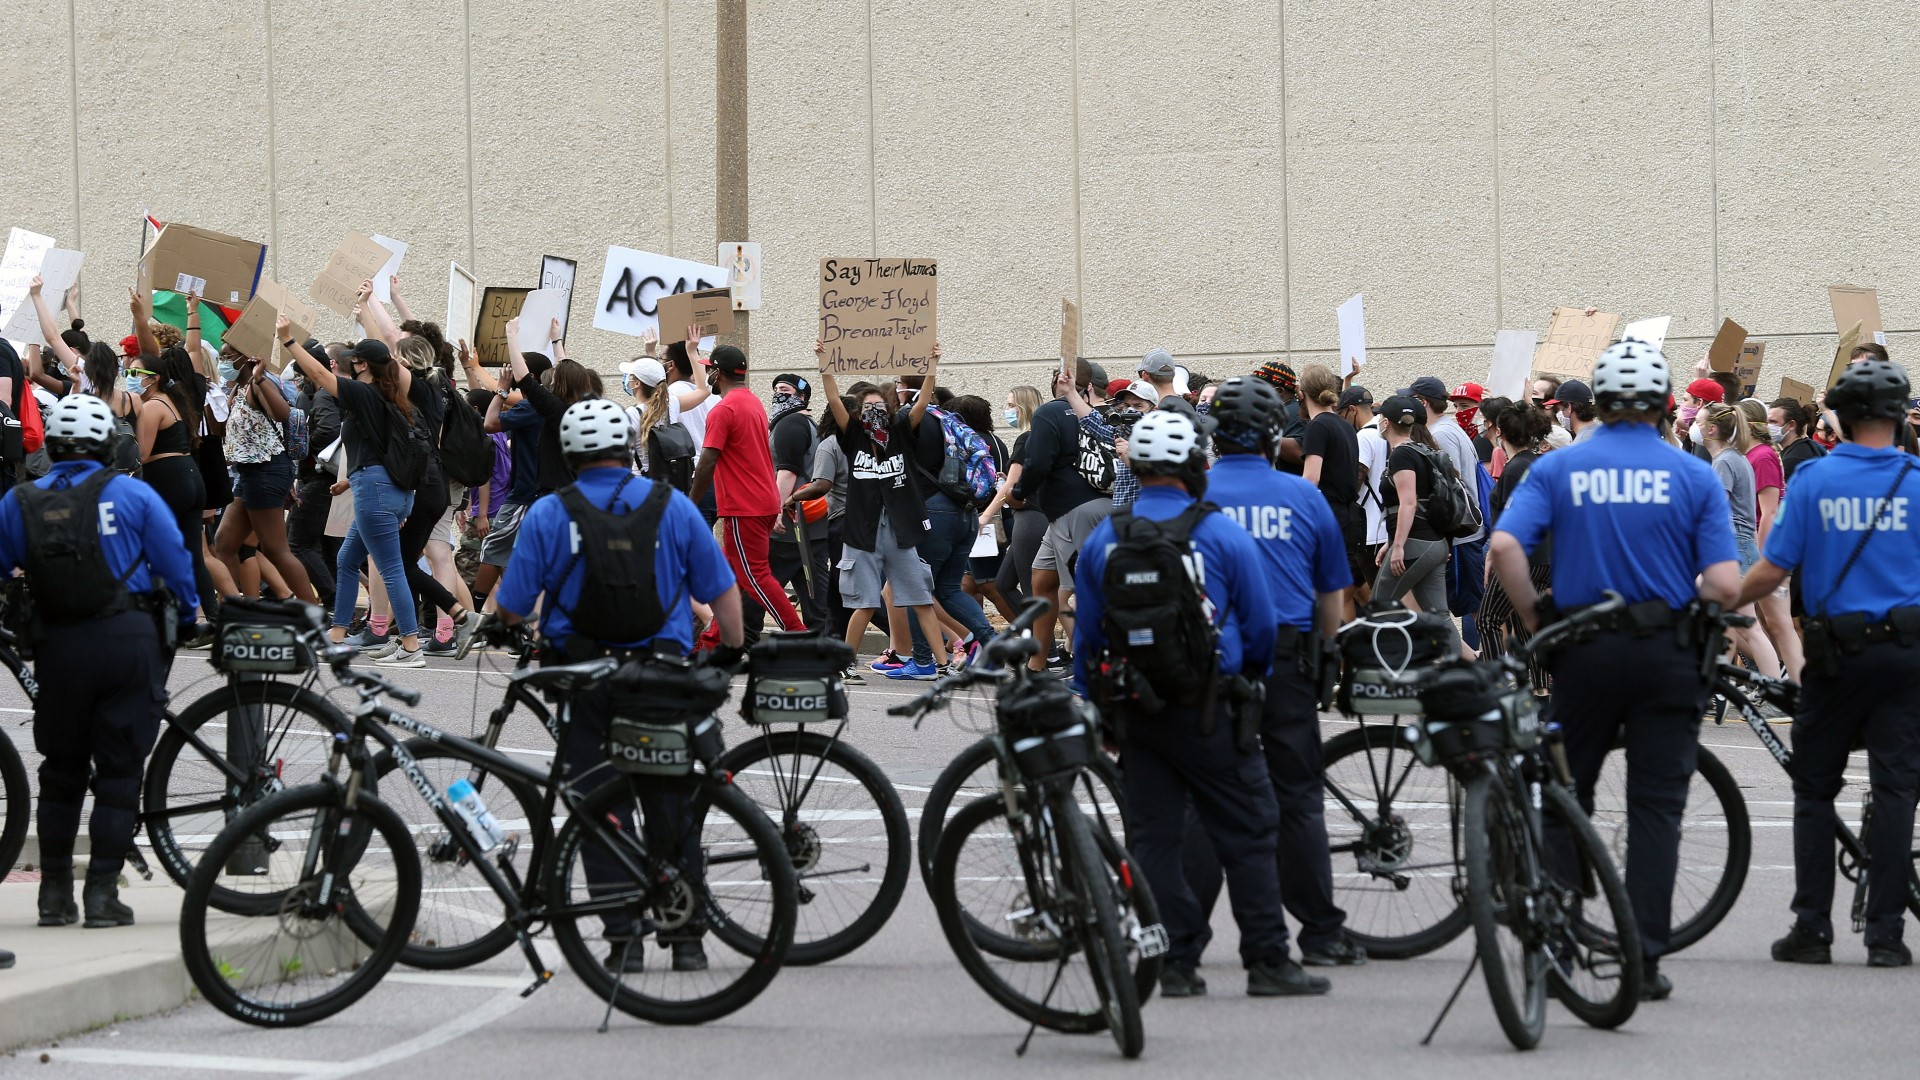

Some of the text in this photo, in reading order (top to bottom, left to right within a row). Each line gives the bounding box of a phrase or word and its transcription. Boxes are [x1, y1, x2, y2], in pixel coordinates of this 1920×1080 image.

[350, 243, 378, 265] WHITE
[824, 257, 938, 285] Say Their Names
[822, 287, 929, 314] George Floyd
[820, 313, 928, 343] Breonna Taylor
[820, 344, 930, 374] Ahmed Aubrey
[1569, 467, 1671, 507] POLICE
[1220, 505, 1292, 541] OLICE
[1818, 496, 1909, 532] POLICE
[1125, 571, 1160, 585] POLICE
[223, 644, 296, 660] POLICE
[755, 694, 828, 711] POLICE
[389, 712, 442, 742] POLICE
[612, 742, 688, 764] POLICE
